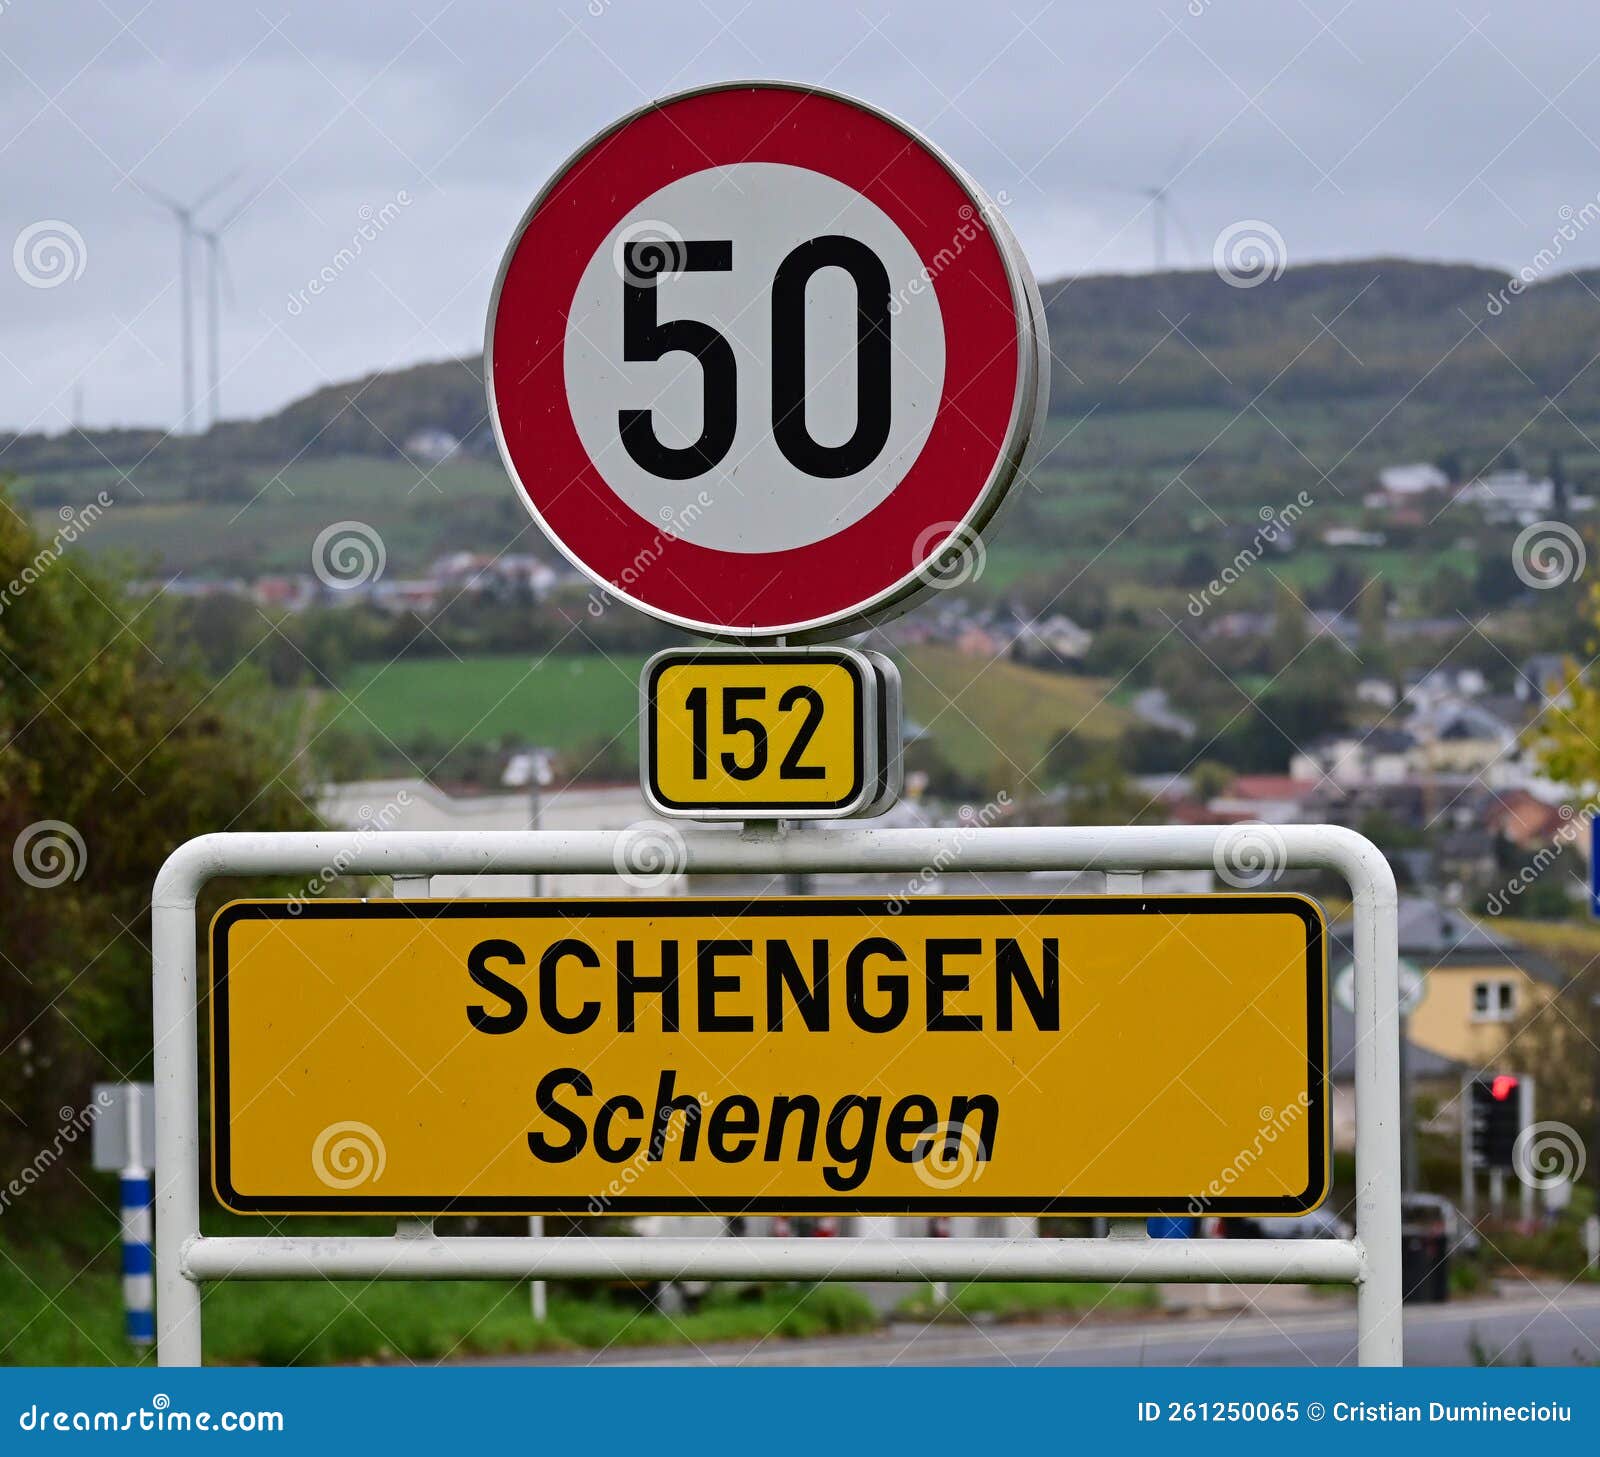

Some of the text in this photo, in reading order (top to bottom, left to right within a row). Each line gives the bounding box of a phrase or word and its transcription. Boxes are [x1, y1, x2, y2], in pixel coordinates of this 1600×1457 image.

[618, 235, 892, 480] 50
[685, 685, 826, 781] 152
[467, 938, 1061, 1035] SCHENGEN
[528, 1068, 1000, 1192] Schengen
